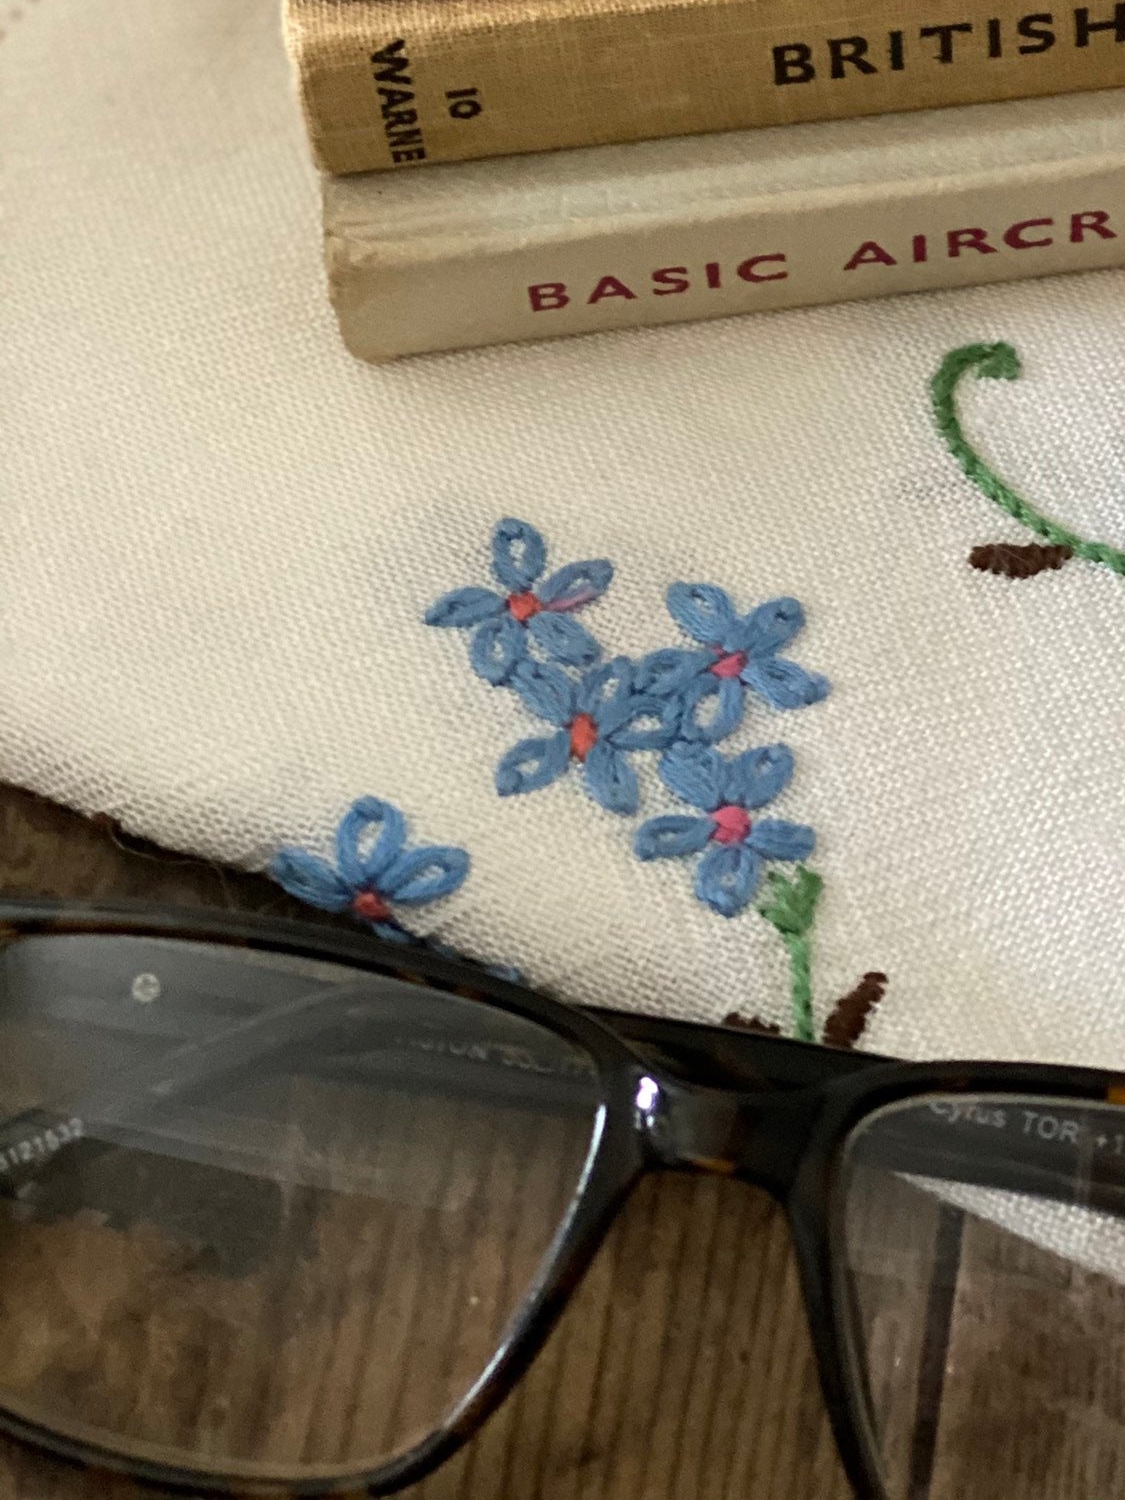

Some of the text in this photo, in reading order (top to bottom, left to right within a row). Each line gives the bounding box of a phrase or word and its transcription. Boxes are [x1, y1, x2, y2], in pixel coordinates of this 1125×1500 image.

[370, 39, 427, 163] WARNE
[445, 87, 482, 119] 10
[527, 253, 788, 312] BASIC
[1020, 1110, 1080, 1145] TOR
